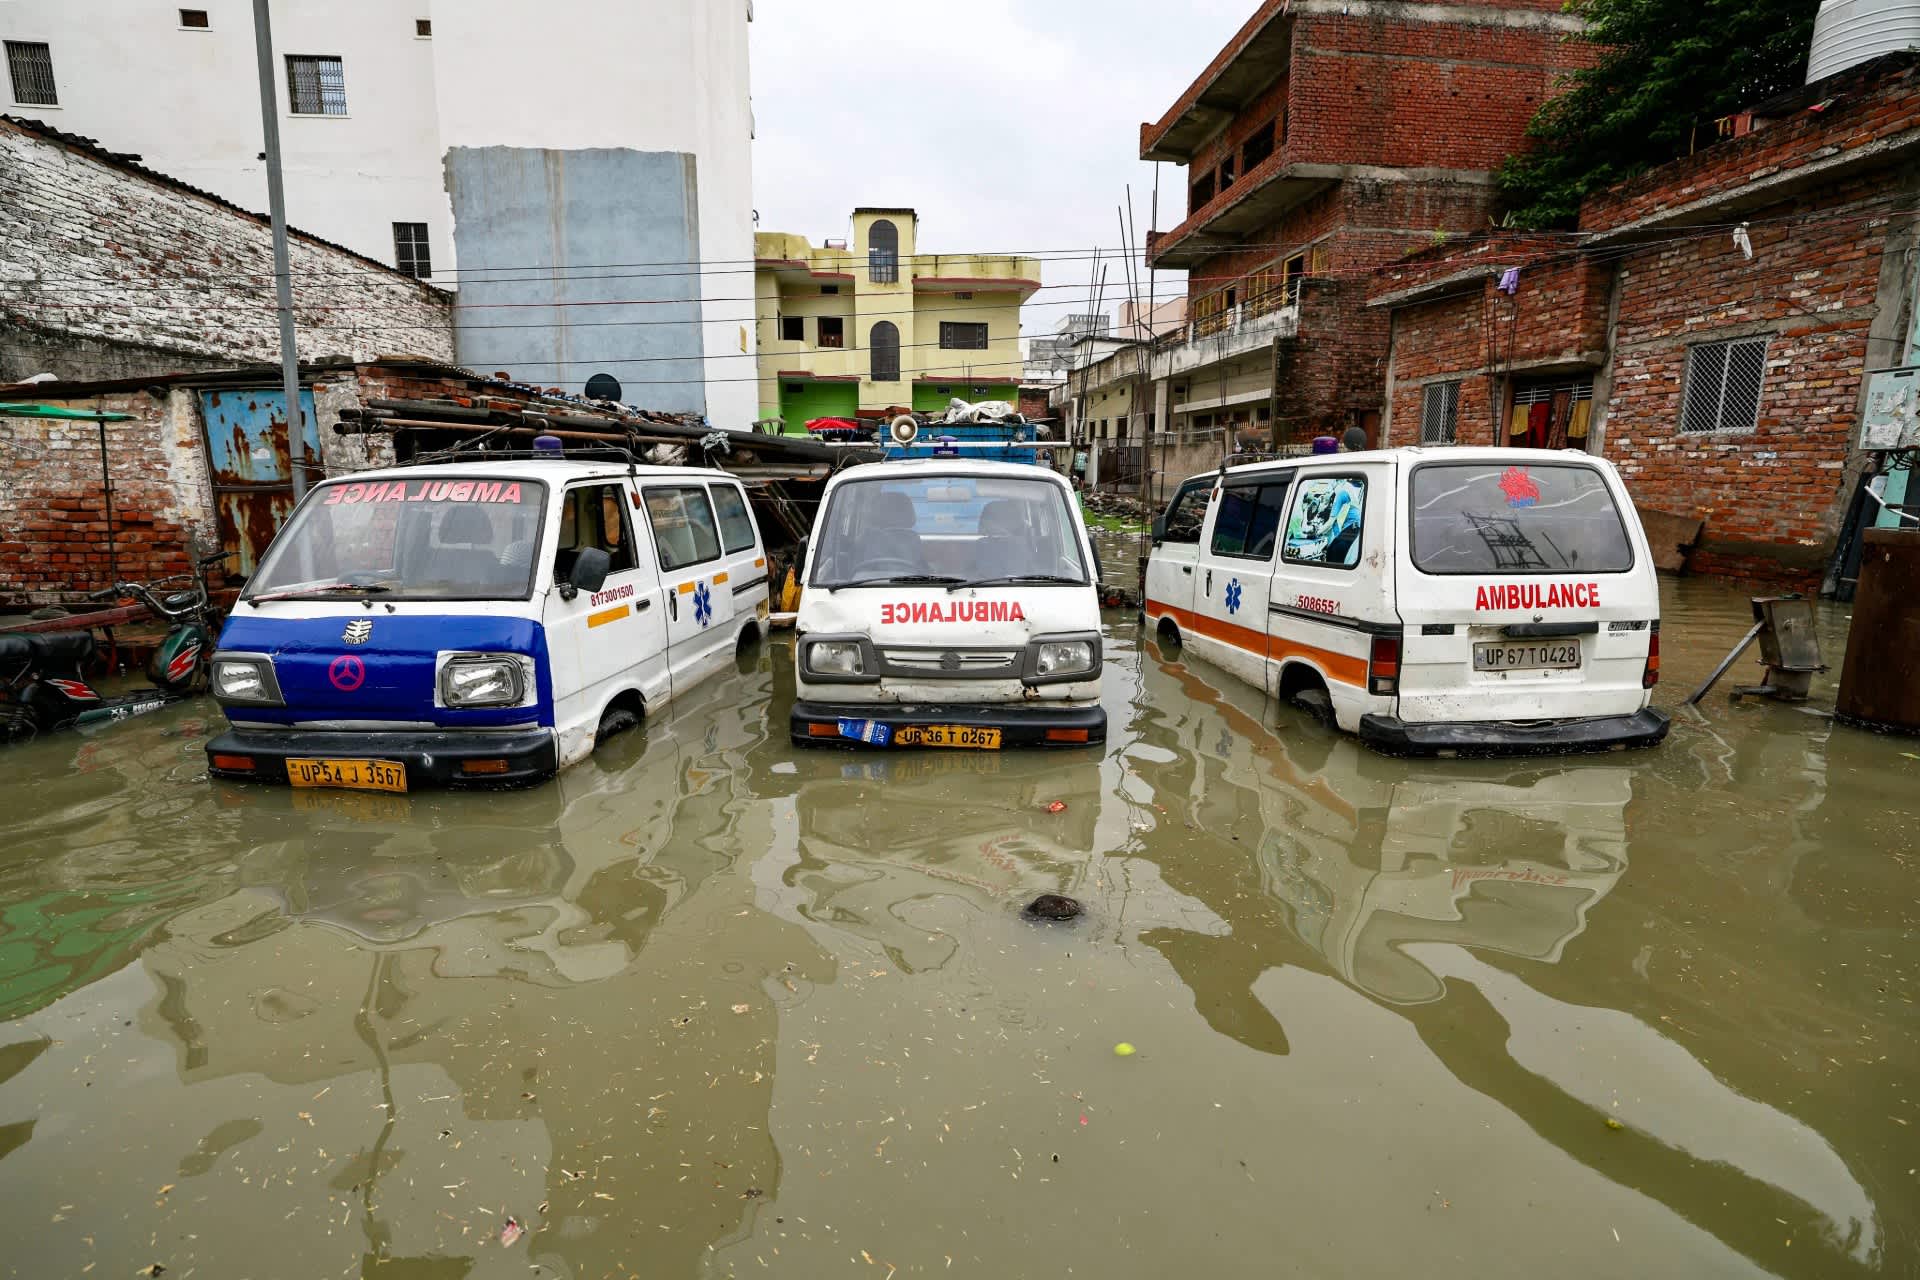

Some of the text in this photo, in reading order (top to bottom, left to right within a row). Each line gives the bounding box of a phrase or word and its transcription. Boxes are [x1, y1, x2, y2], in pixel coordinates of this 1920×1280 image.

[591, 584, 634, 606] 8173001500
[1475, 583, 1600, 611] AMBULANCE
[1486, 647, 1576, 665] UP 67 T 0428
[927, 731, 943, 743] 36
[947, 731, 956, 743] T
[961, 731, 994, 745] 0267
[301, 765, 343, 783] UP54
[351, 766, 359, 783] J
[366, 766, 401, 786] 3567
